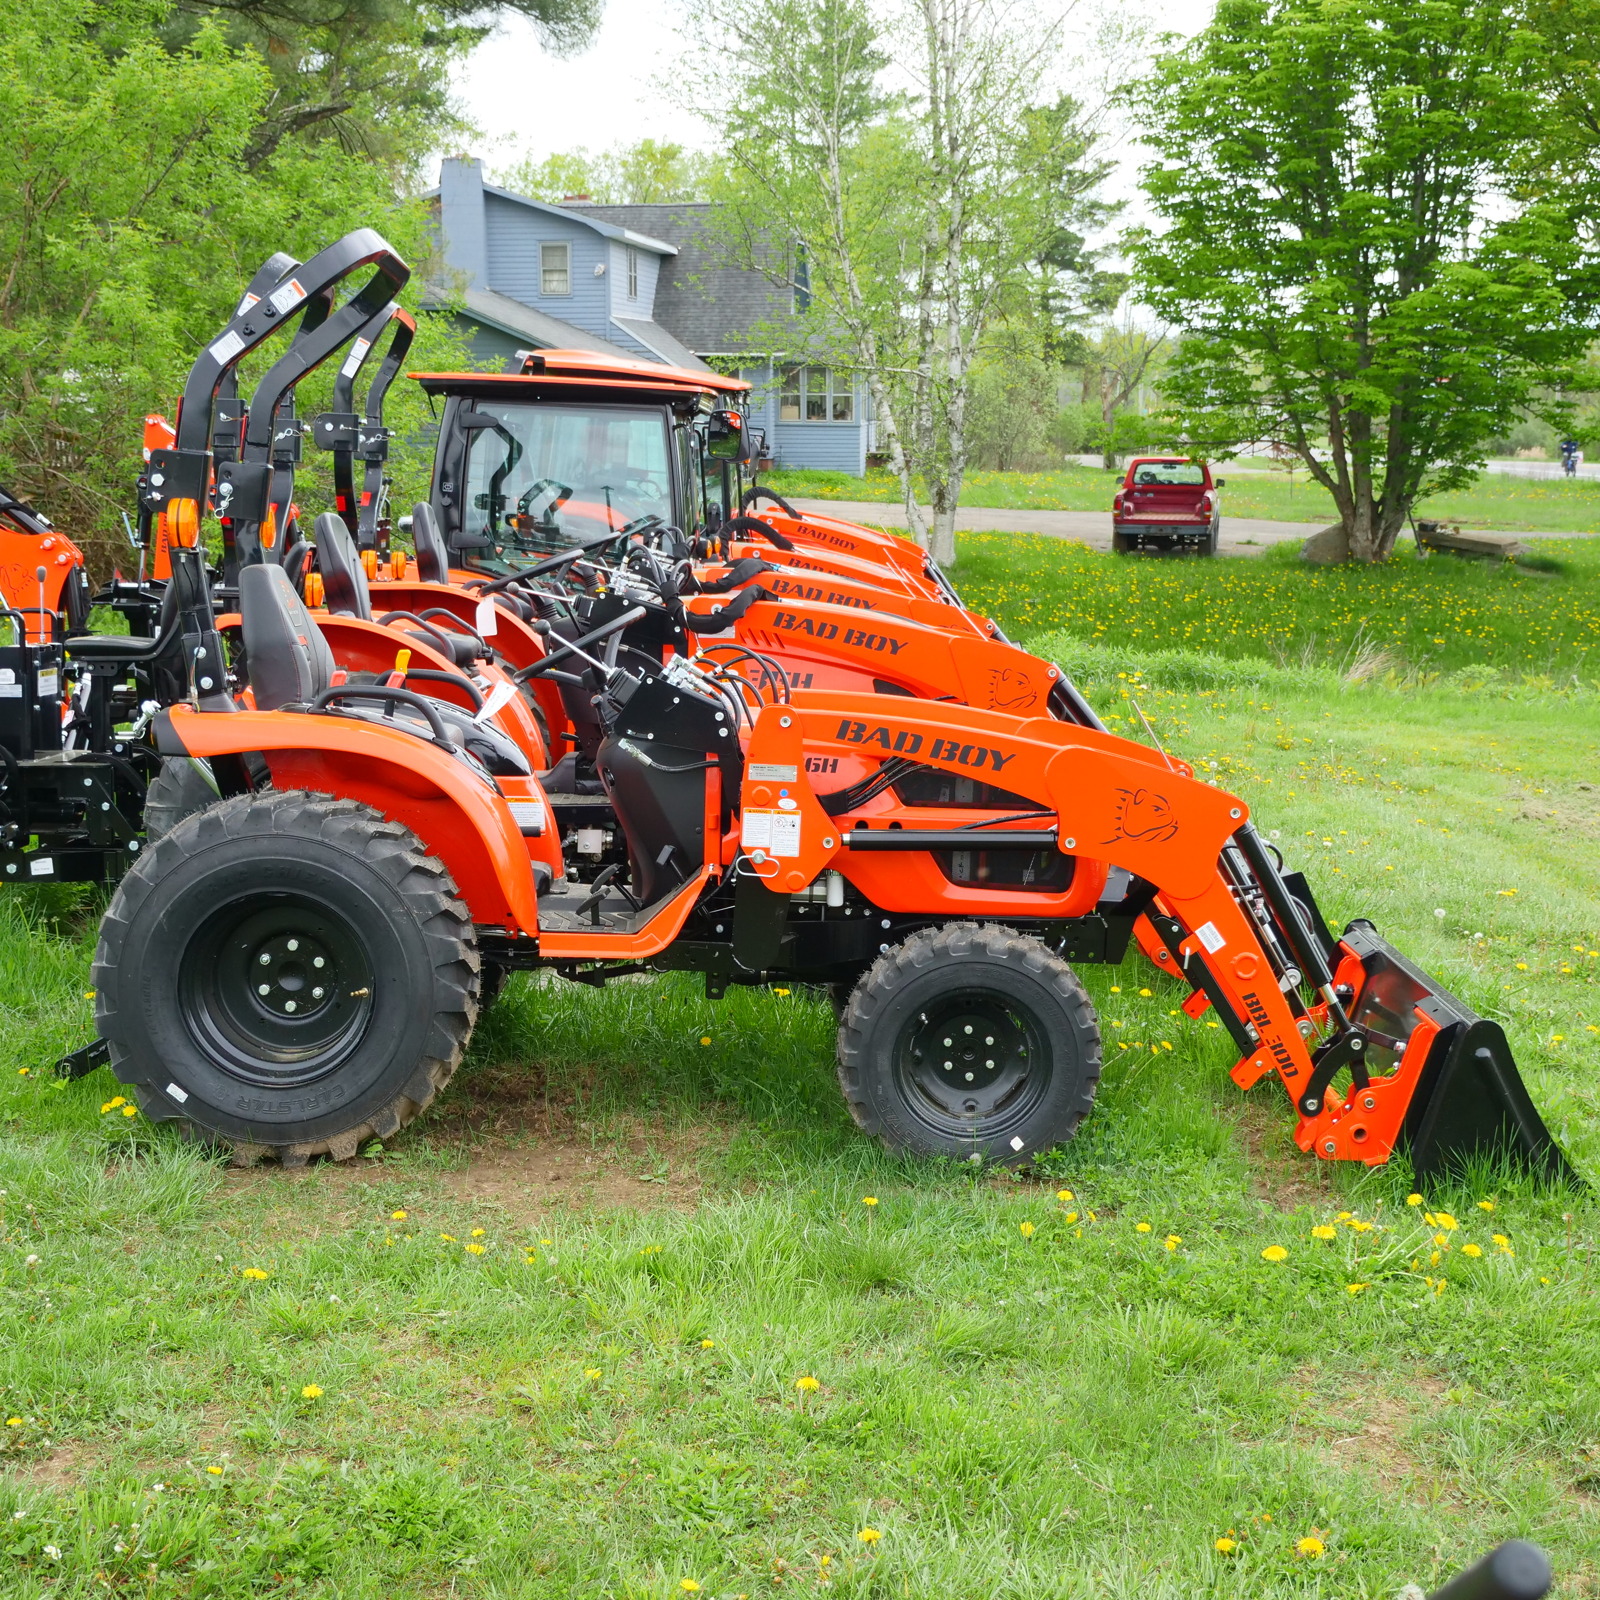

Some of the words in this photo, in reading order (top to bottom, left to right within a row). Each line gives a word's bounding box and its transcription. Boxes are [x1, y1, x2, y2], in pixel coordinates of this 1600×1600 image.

[797, 525, 827, 541] BAD
[829, 536, 859, 550] BOY
[771, 579, 823, 601] BAD
[826, 592, 878, 610] BOY
[772, 612, 839, 640] BAD
[843, 629, 908, 655] BOY
[835, 719, 923, 754] BAD
[929, 738, 1016, 772] BOY
[1242, 992, 1271, 1034] BBL
[1266, 1035, 1299, 1078] 300
[237, 1084, 346, 1115] CARLSTAR
